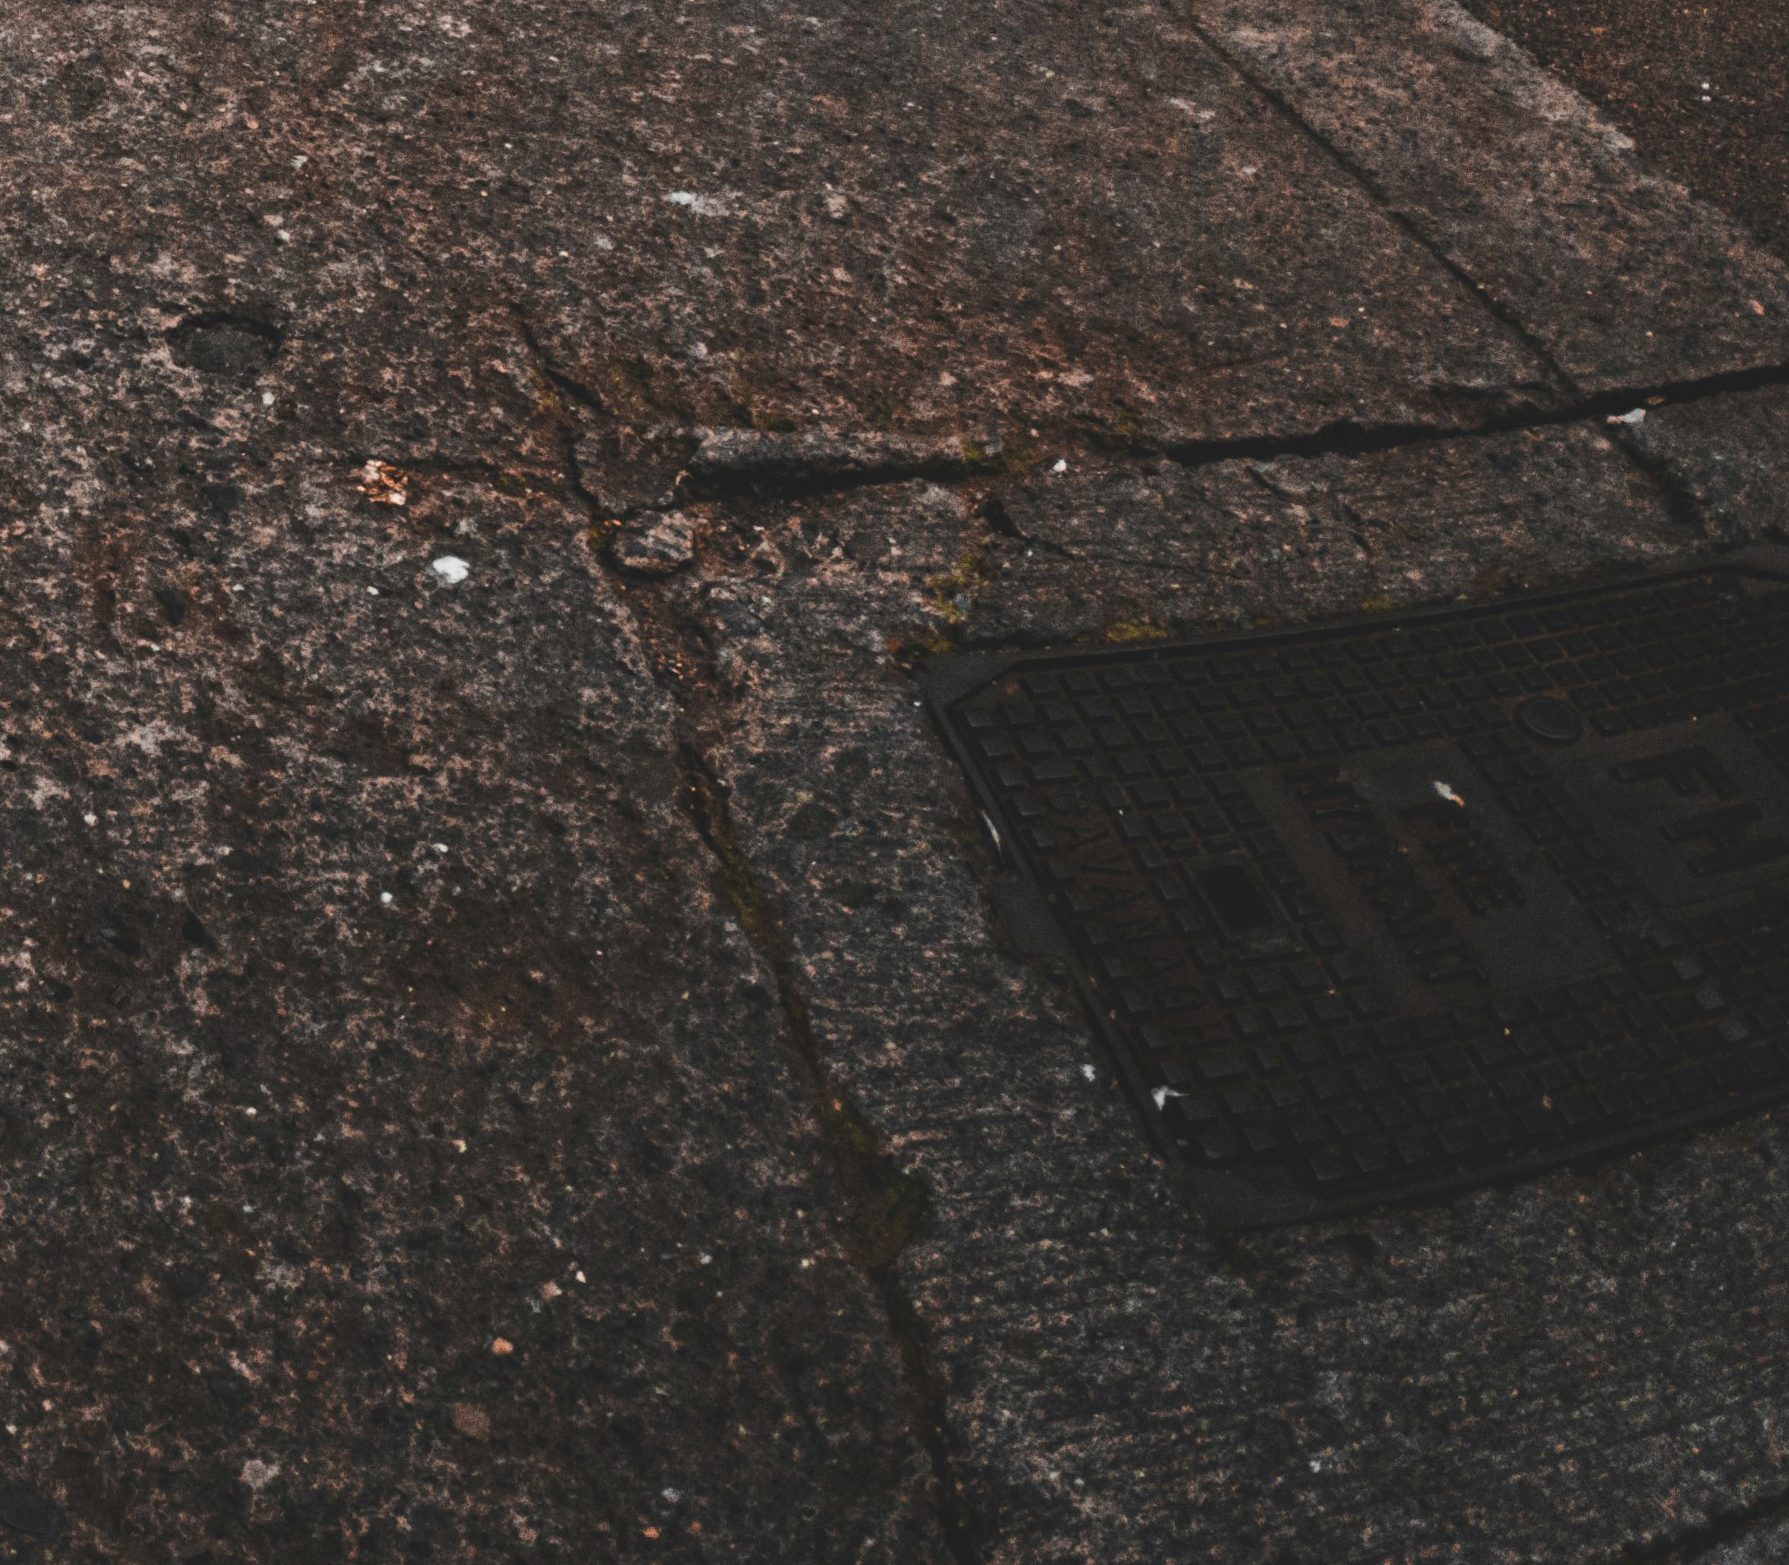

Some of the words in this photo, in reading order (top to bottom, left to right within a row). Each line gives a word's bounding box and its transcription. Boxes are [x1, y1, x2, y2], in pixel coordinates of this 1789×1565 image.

[1284, 765, 1491, 987] HYDRANT
[1401, 802, 1527, 917] FIRE
[1609, 746, 1789, 877] FH
